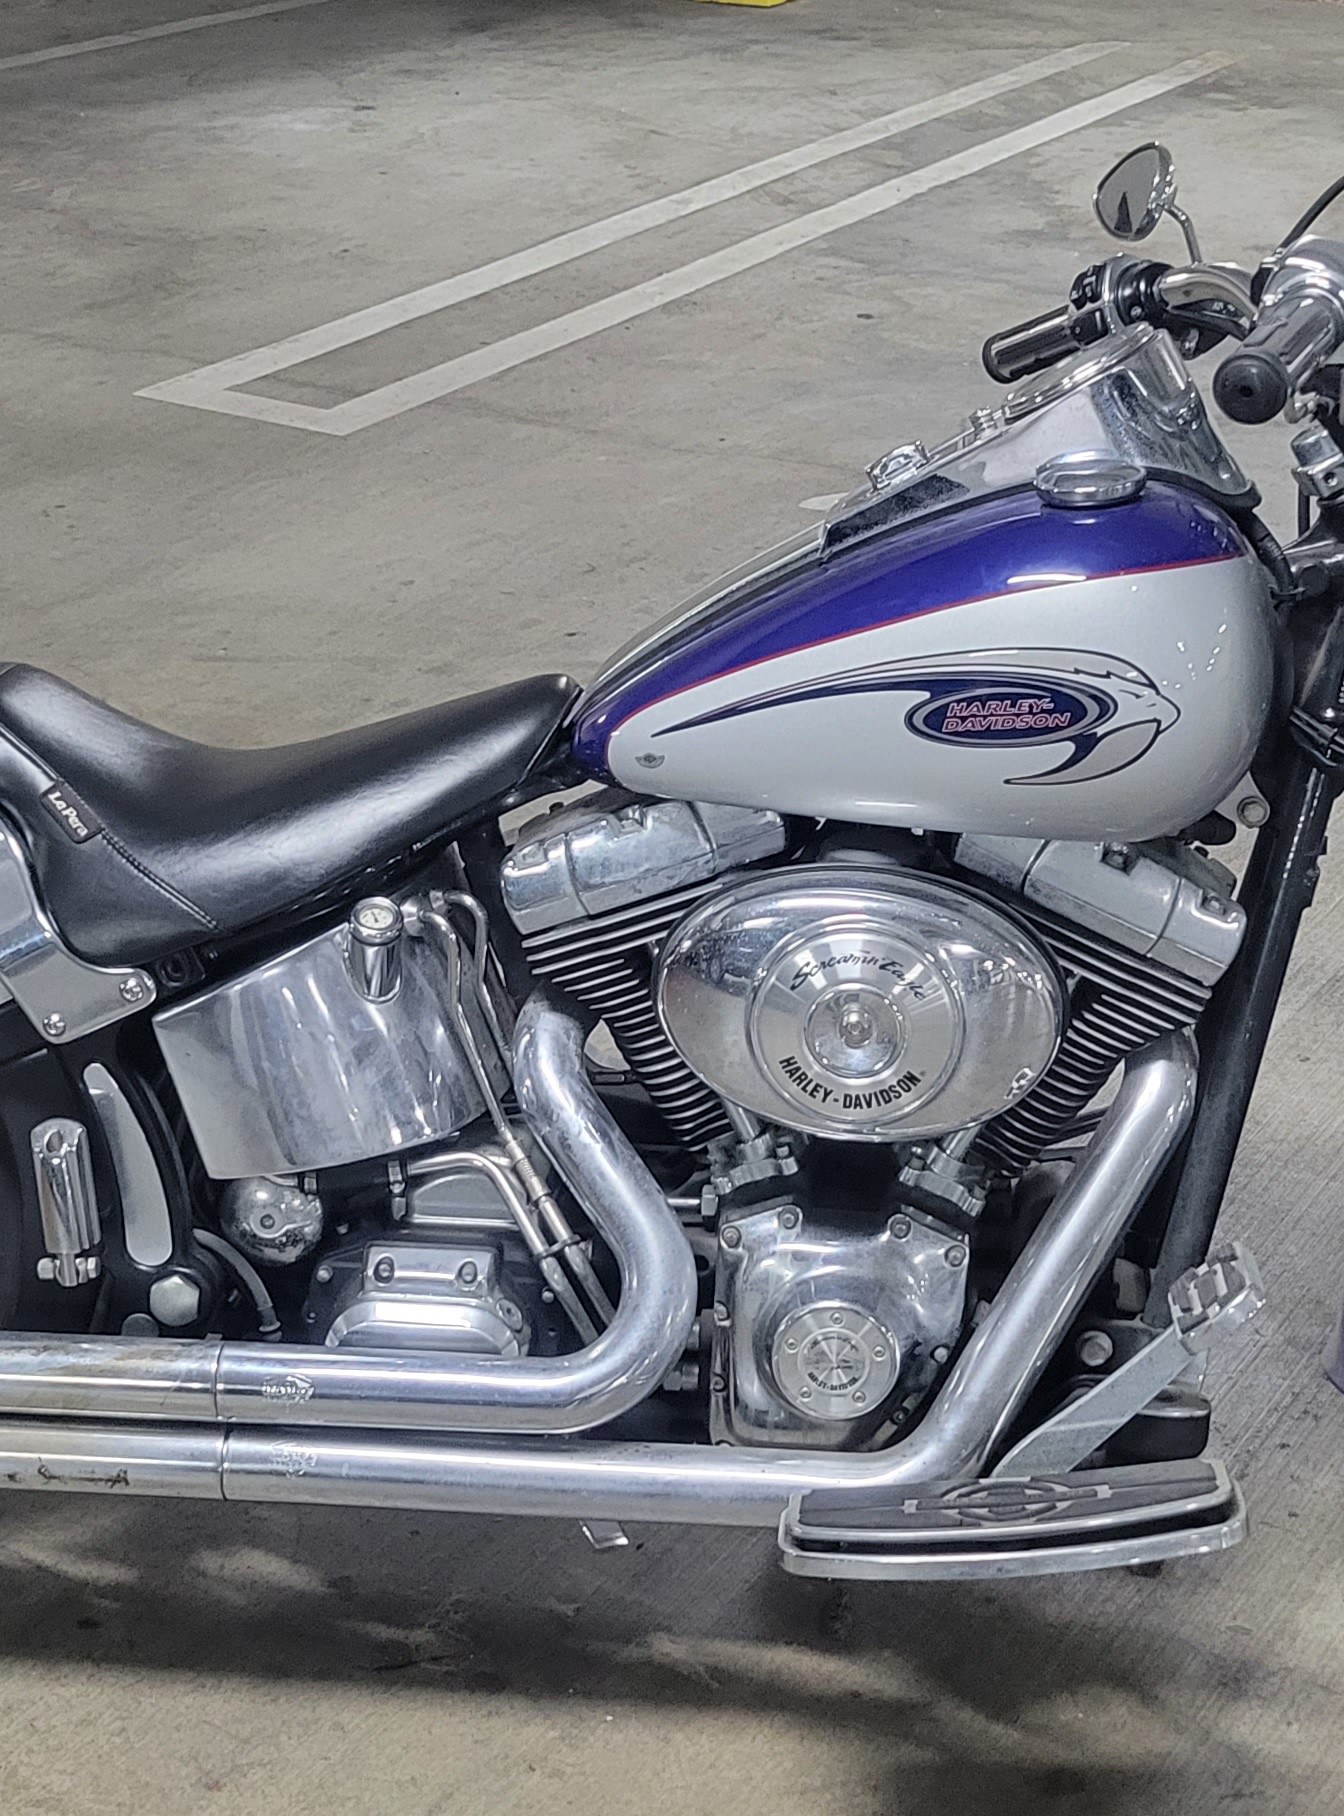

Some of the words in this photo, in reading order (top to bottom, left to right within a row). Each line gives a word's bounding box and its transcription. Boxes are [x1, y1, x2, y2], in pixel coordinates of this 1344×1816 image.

[946, 697, 1055, 717] HARLEY-
[942, 712, 1071, 732] DAVIDSON
[878, 960, 926, 1001] Eagle
